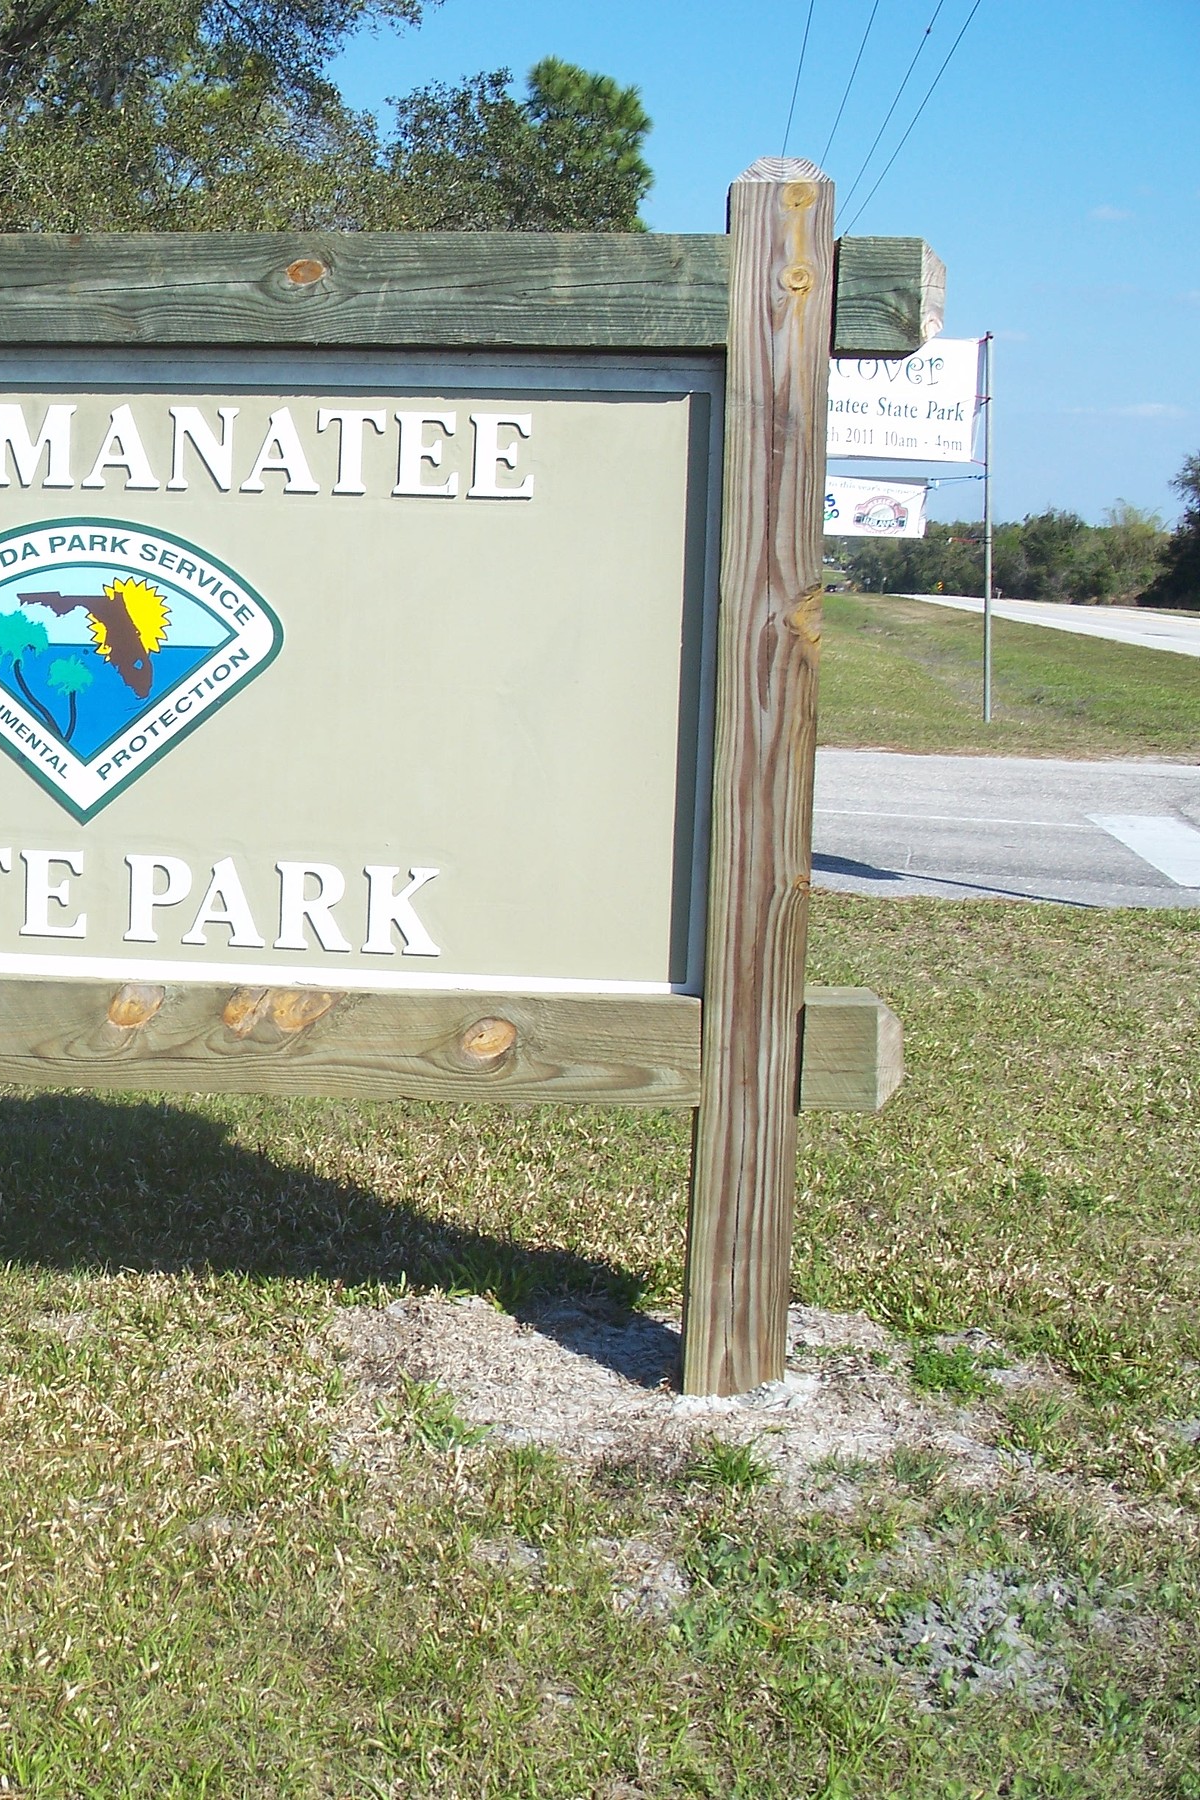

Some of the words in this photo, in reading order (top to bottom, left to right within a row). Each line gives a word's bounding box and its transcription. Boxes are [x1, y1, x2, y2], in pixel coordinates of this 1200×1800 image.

[846, 428, 873, 445] 2011
[885, 431, 918, 448] 10am
[877, 397, 918, 419] State
[926, 401, 965, 421] Park
[48, 534, 131, 555] PARK
[139, 543, 255, 626] SERVICE
[96, 647, 250, 781] PROTECTION
[122, 854, 442, 958] PARK
